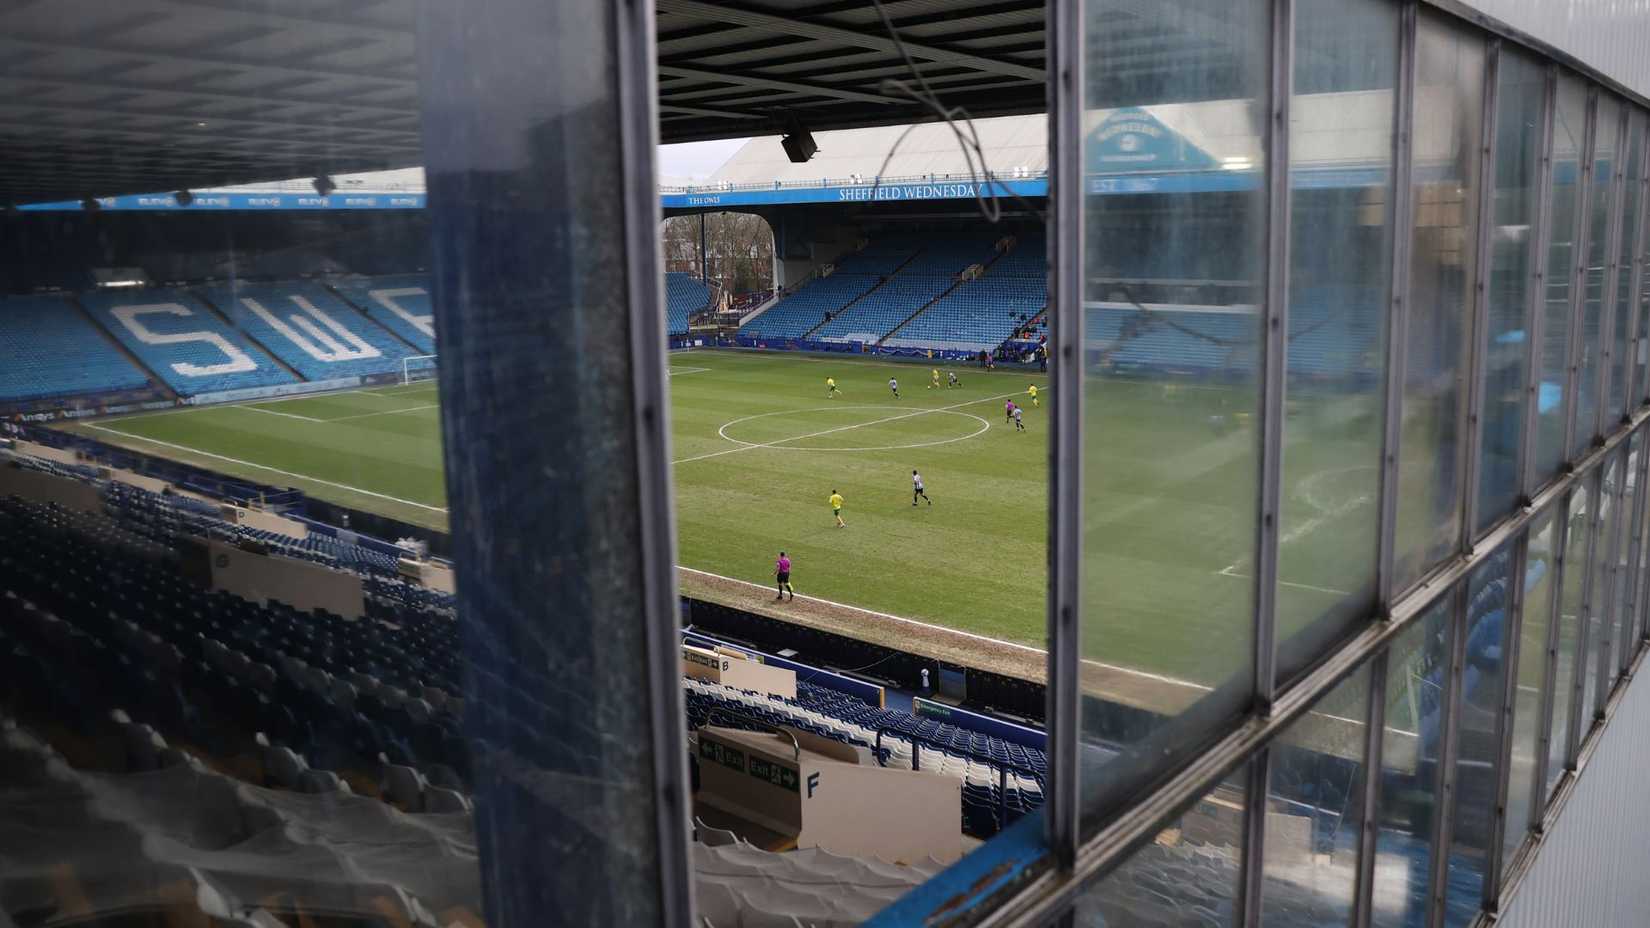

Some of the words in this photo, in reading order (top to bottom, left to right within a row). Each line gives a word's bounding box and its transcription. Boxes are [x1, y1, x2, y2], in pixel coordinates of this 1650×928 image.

[839, 186, 901, 201] SHEFFIELD
[722, 661, 729, 672] B
[807, 771, 820, 799] F
